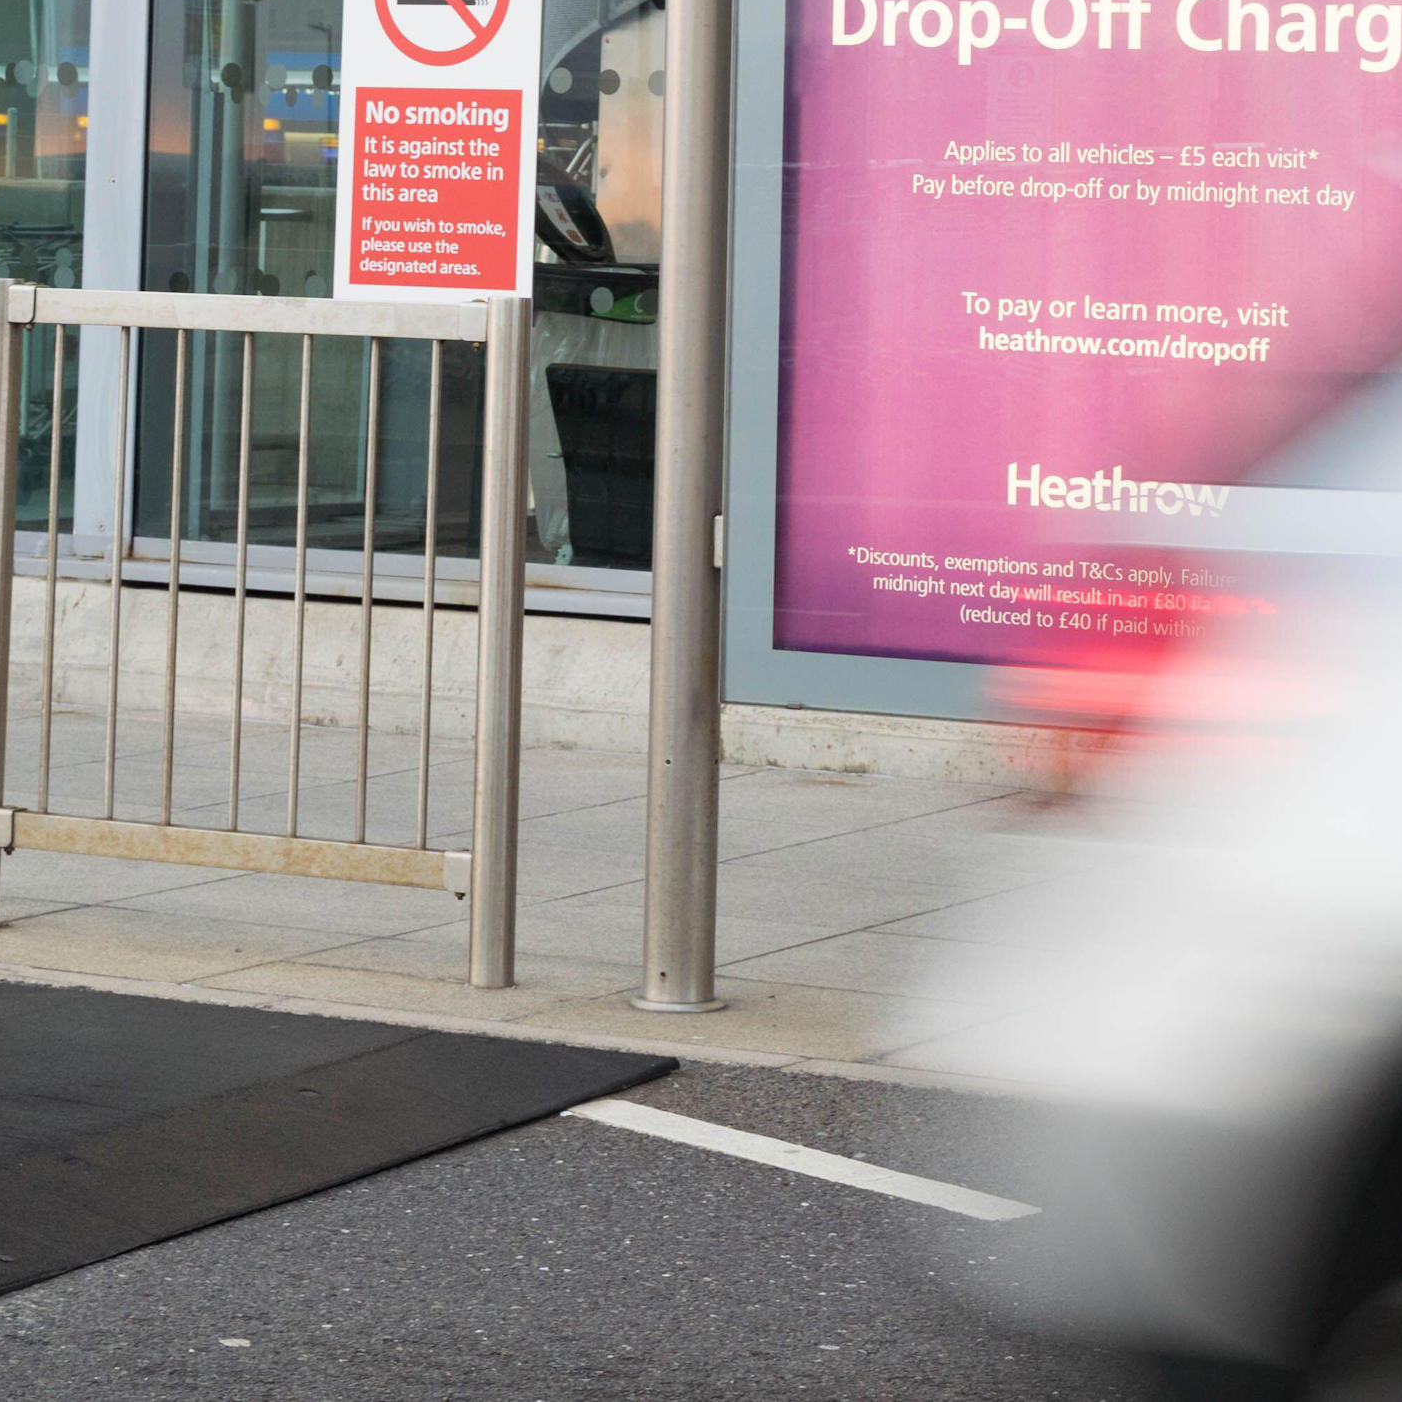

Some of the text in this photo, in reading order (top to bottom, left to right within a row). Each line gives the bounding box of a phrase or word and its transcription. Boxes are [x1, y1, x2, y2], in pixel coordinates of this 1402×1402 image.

[365, 101, 509, 133] No smoking
[364, 135, 500, 159] It is against the
[944, 140, 1016, 166] Applies
[1021, 145, 1043, 164] to
[1048, 142, 1071, 164] all
[1076, 143, 1155, 166] vehicles
[1180, 145, 1206, 167] £5
[1211, 146, 1260, 168] each
[363, 159, 504, 180] law to smoke in
[361, 183, 439, 203] this area
[912, 174, 1356, 211] Pay before drop-off or by midnight next day
[362, 216, 506, 237] If you wish to smoke,
[361, 237, 459, 254] please use the
[360, 257, 481, 276] designated areas.
[961, 291, 1290, 328] To pay or learn more, visit
[978, 326, 1270, 366] heathrow.com/dropoff
[1007, 462, 1231, 518] Heathrow
[944, 553, 1038, 582] exemptions
[1042, 558, 1074, 578] and
[1078, 561, 1123, 582] T&Cs
[1128, 565, 1175, 589] apply.
[873, 572, 946, 598] midnight
[950, 579, 984, 598] next
[989, 581, 1020, 605] day
[1023, 582, 1051, 602] will
[1056, 585, 1102, 606] result
[1107, 587, 1122, 607] in
[1126, 593, 1148, 609] an
[1154, 592, 1186, 611] £80
[959, 603, 1206, 638] (reduced to £40 if paid within
